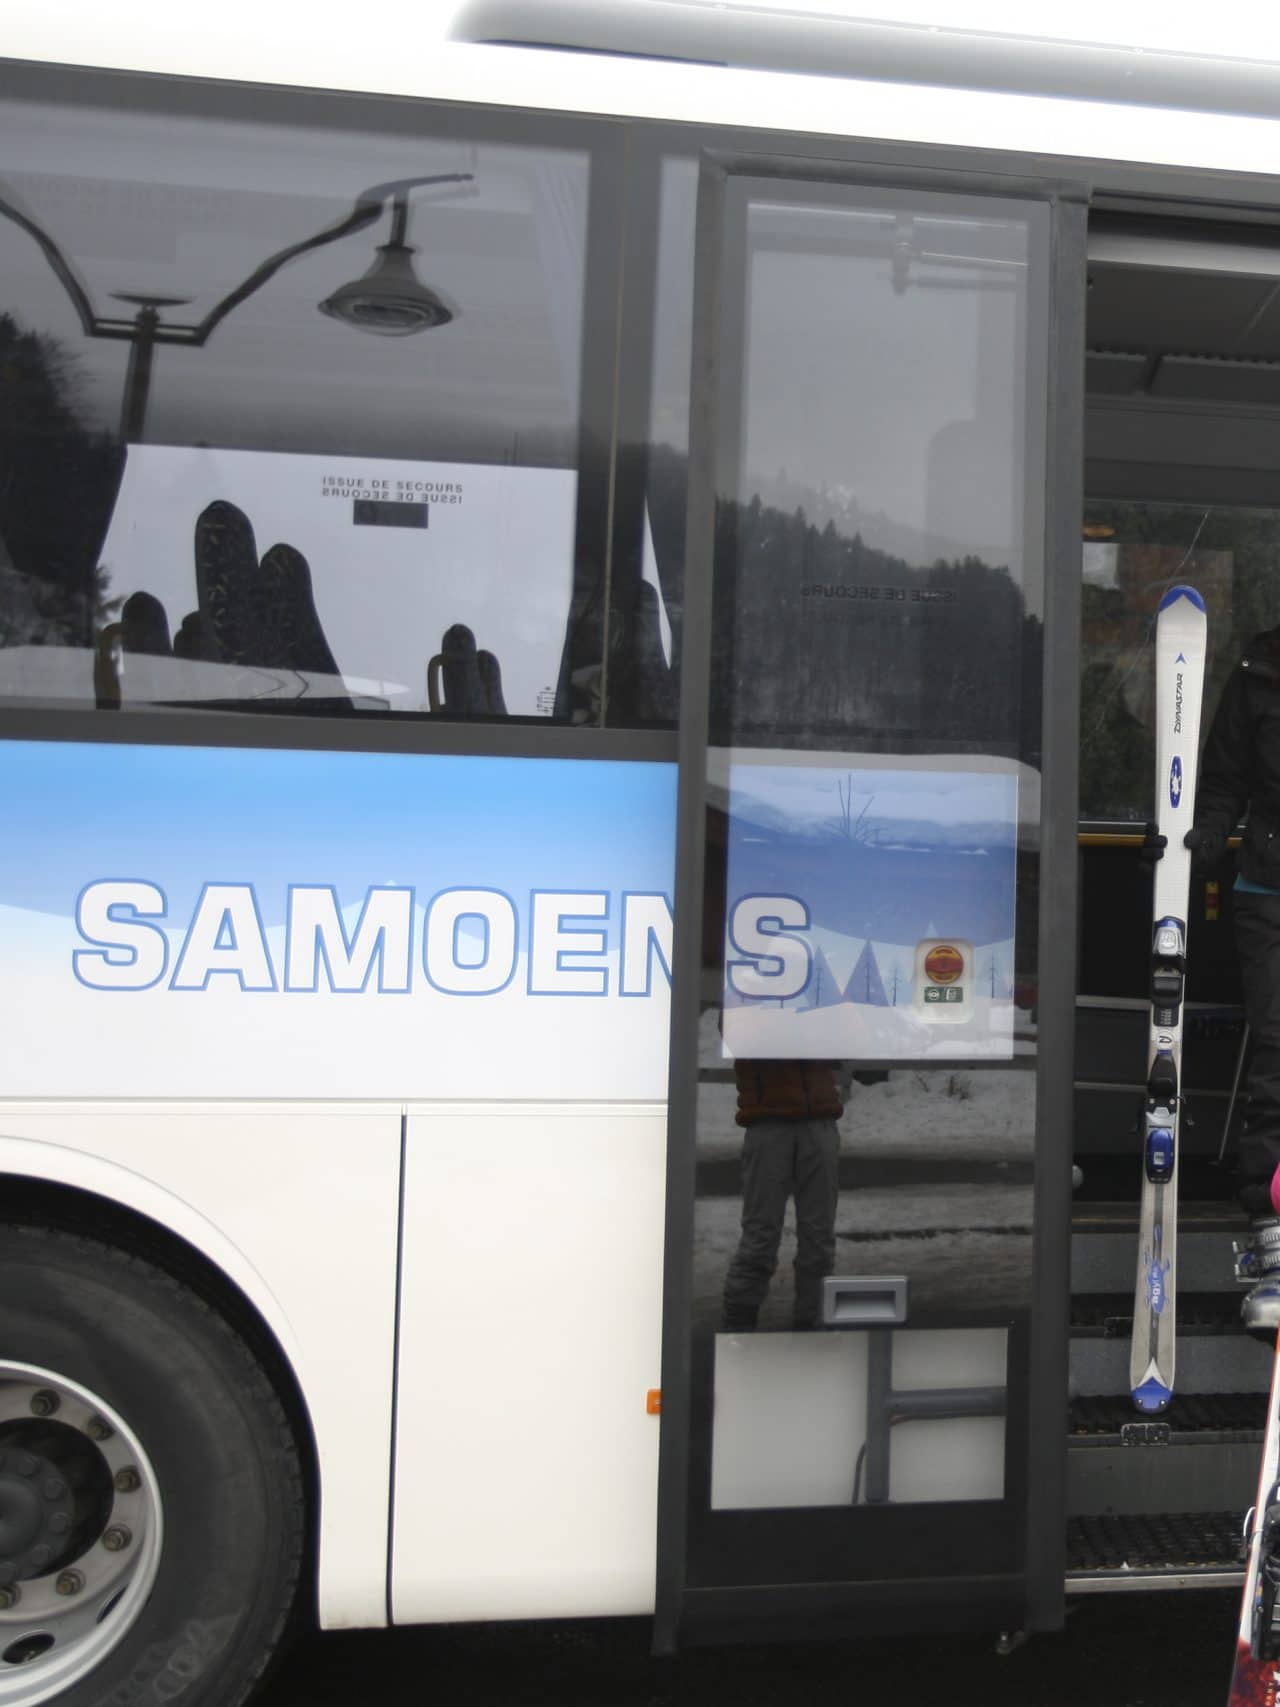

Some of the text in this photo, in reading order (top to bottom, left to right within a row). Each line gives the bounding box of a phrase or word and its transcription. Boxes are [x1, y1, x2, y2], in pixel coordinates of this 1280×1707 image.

[323, 476, 463, 494] ISSUE DE SECOURS
[1173, 672, 1184, 734] DYNASTAR
